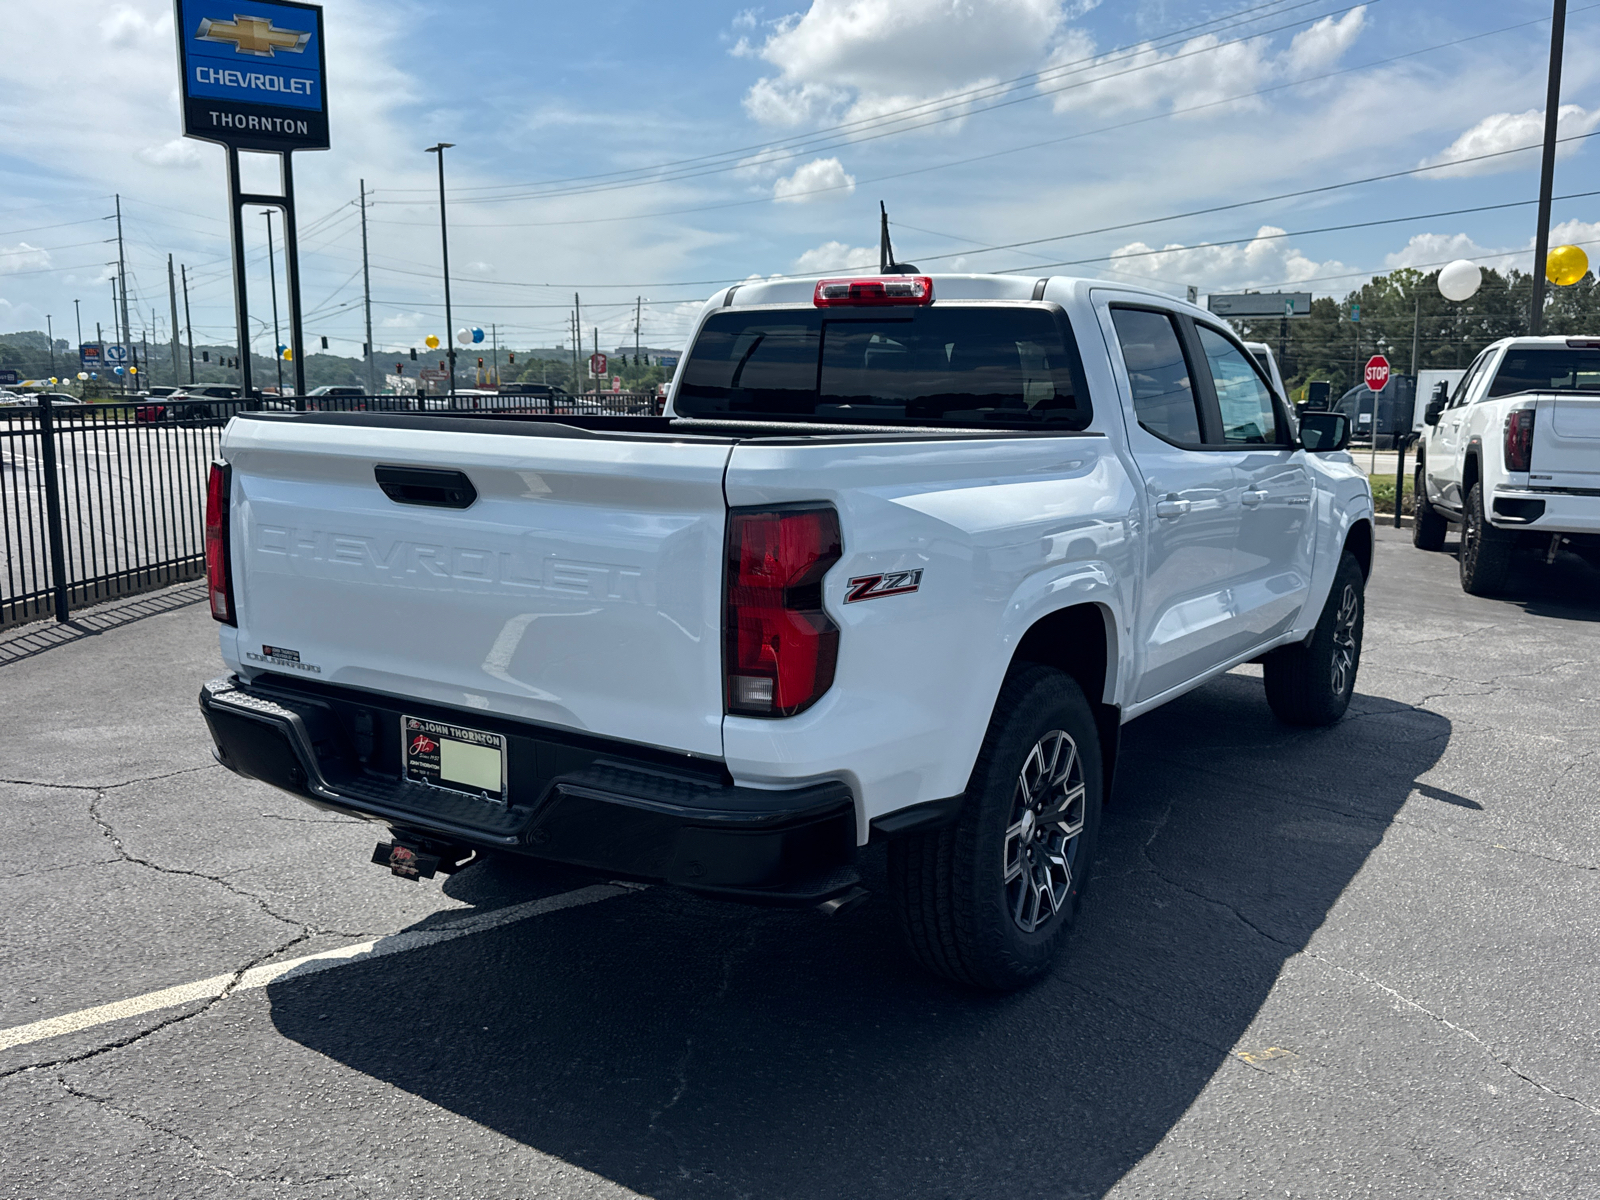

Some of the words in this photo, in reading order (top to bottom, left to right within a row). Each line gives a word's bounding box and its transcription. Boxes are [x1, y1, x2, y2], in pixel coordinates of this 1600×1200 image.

[196, 66, 314, 95] CHEVROLET
[209, 111, 308, 135] THORNTON
[1366, 366, 1388, 381] STOP
[256, 523, 642, 599] CHEVROLET
[843, 568, 924, 605] Z71
[246, 652, 321, 673] COLORADO
[425, 722, 449, 735] JOHN
[449, 728, 500, 746] THORNTON
